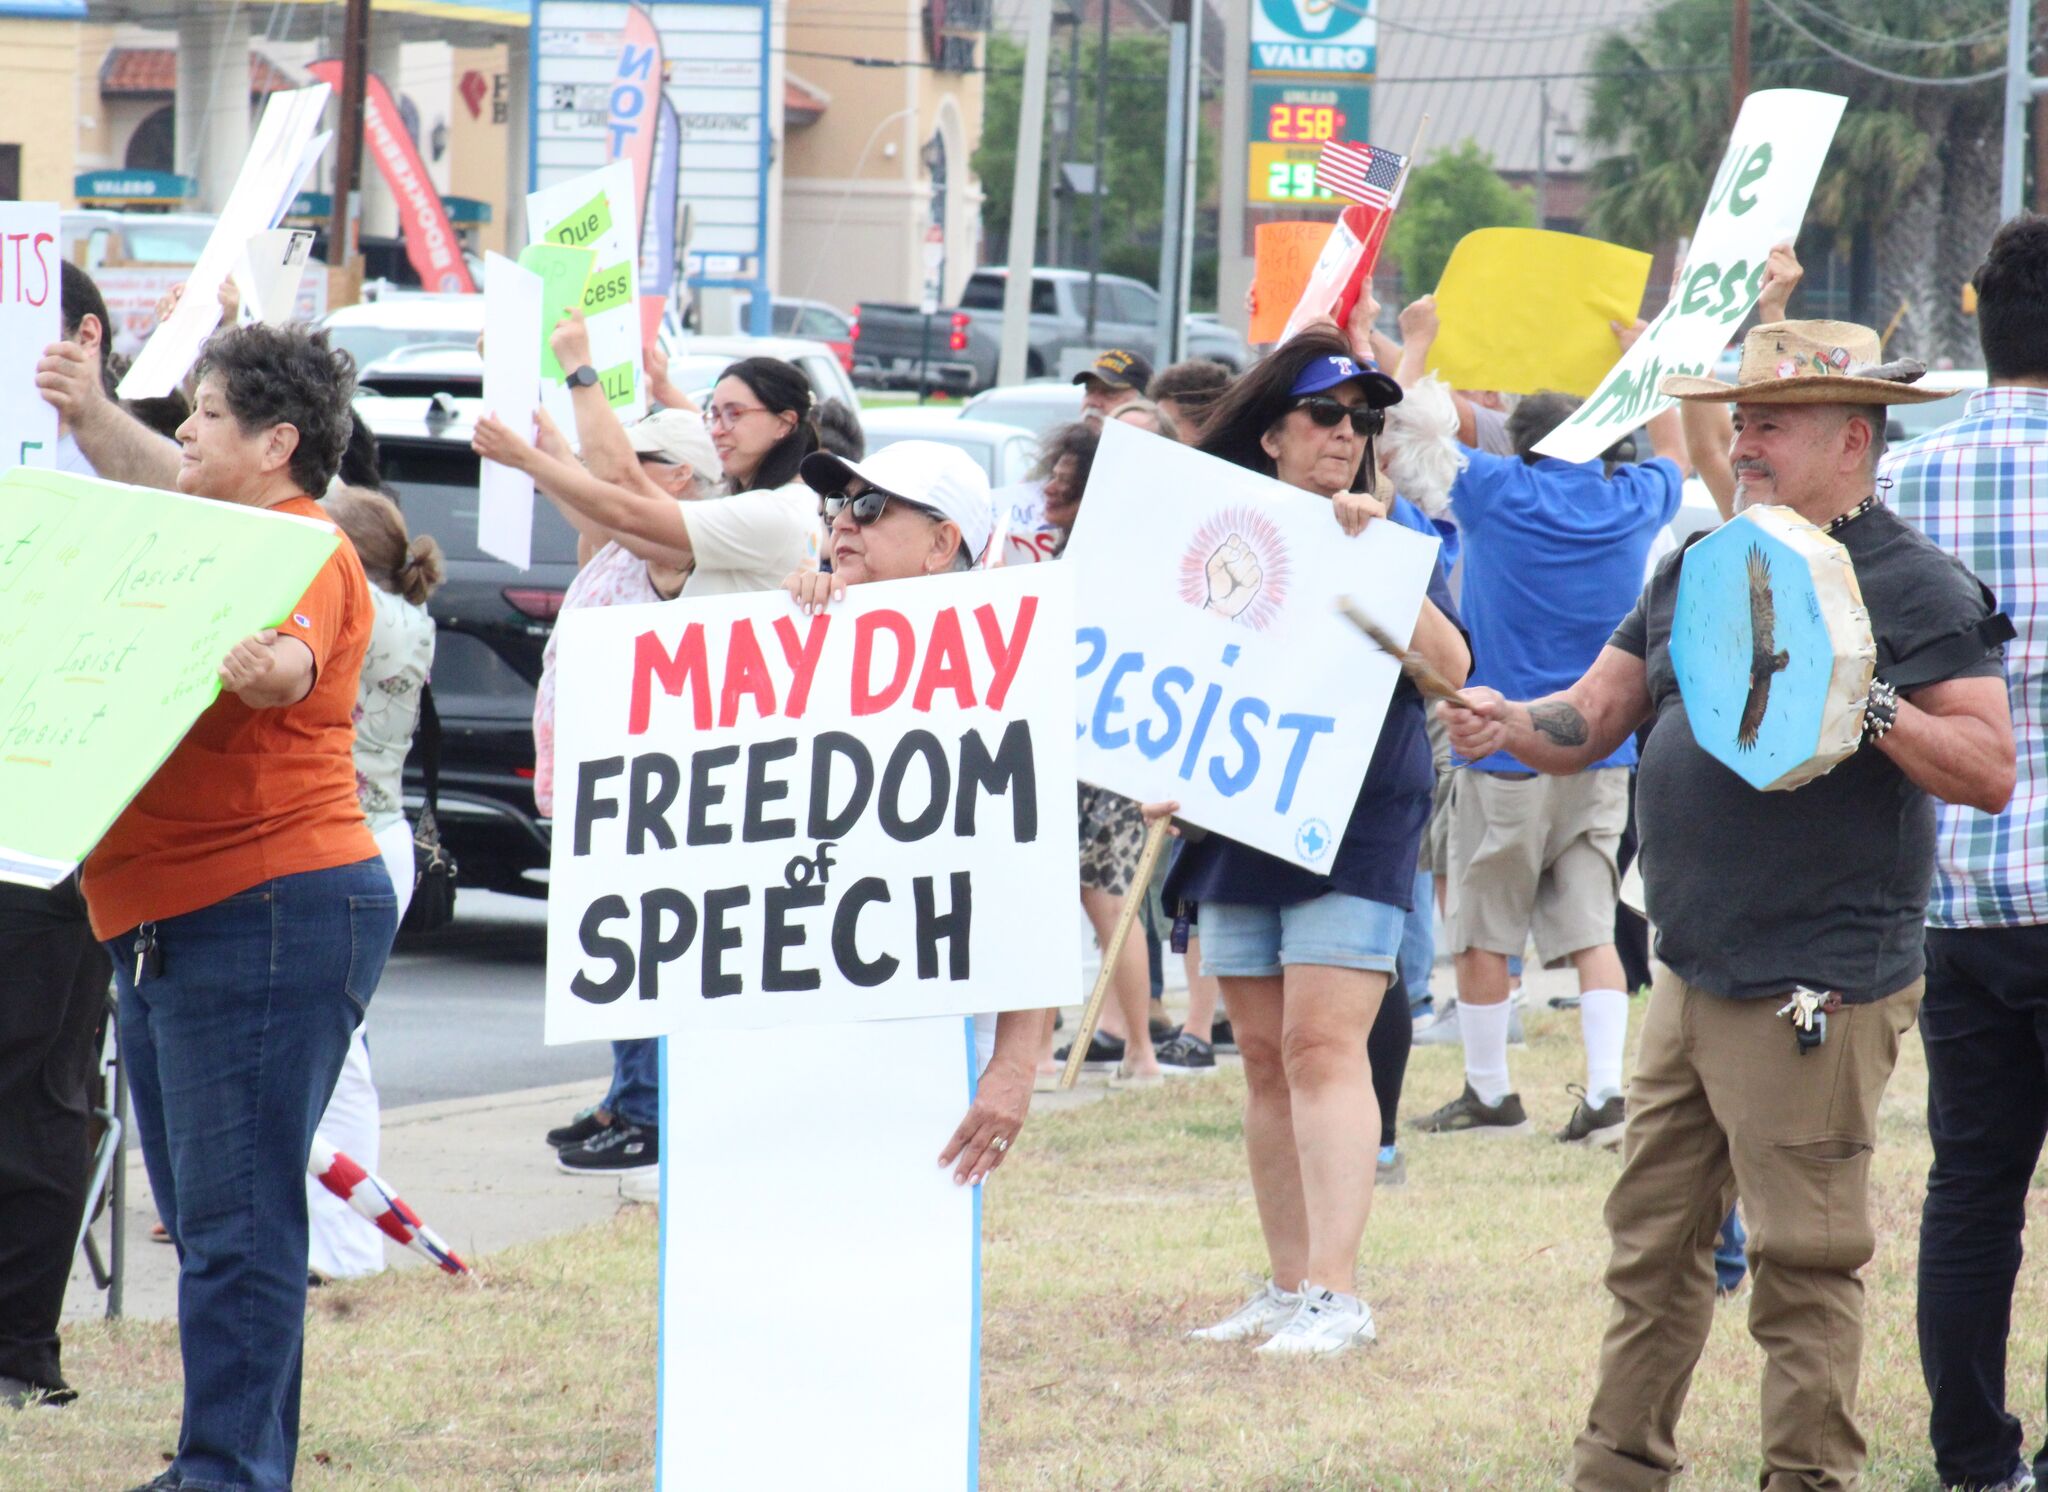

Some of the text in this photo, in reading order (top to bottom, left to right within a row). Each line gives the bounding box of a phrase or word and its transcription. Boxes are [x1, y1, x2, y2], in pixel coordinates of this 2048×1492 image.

[1258, 44, 1367, 69] VALERO
[92, 180, 157, 195] VALERO
[558, 213, 600, 246] Due
[584, 275, 628, 306] cess
[1328, 356, 1353, 376] T
[55, 627, 144, 674] Insist
[628, 595, 1039, 735] MAY DAY
[573, 719, 1039, 857] FREEDOM
[785, 842, 837, 889] of
[570, 870, 972, 1004] SPEECH
